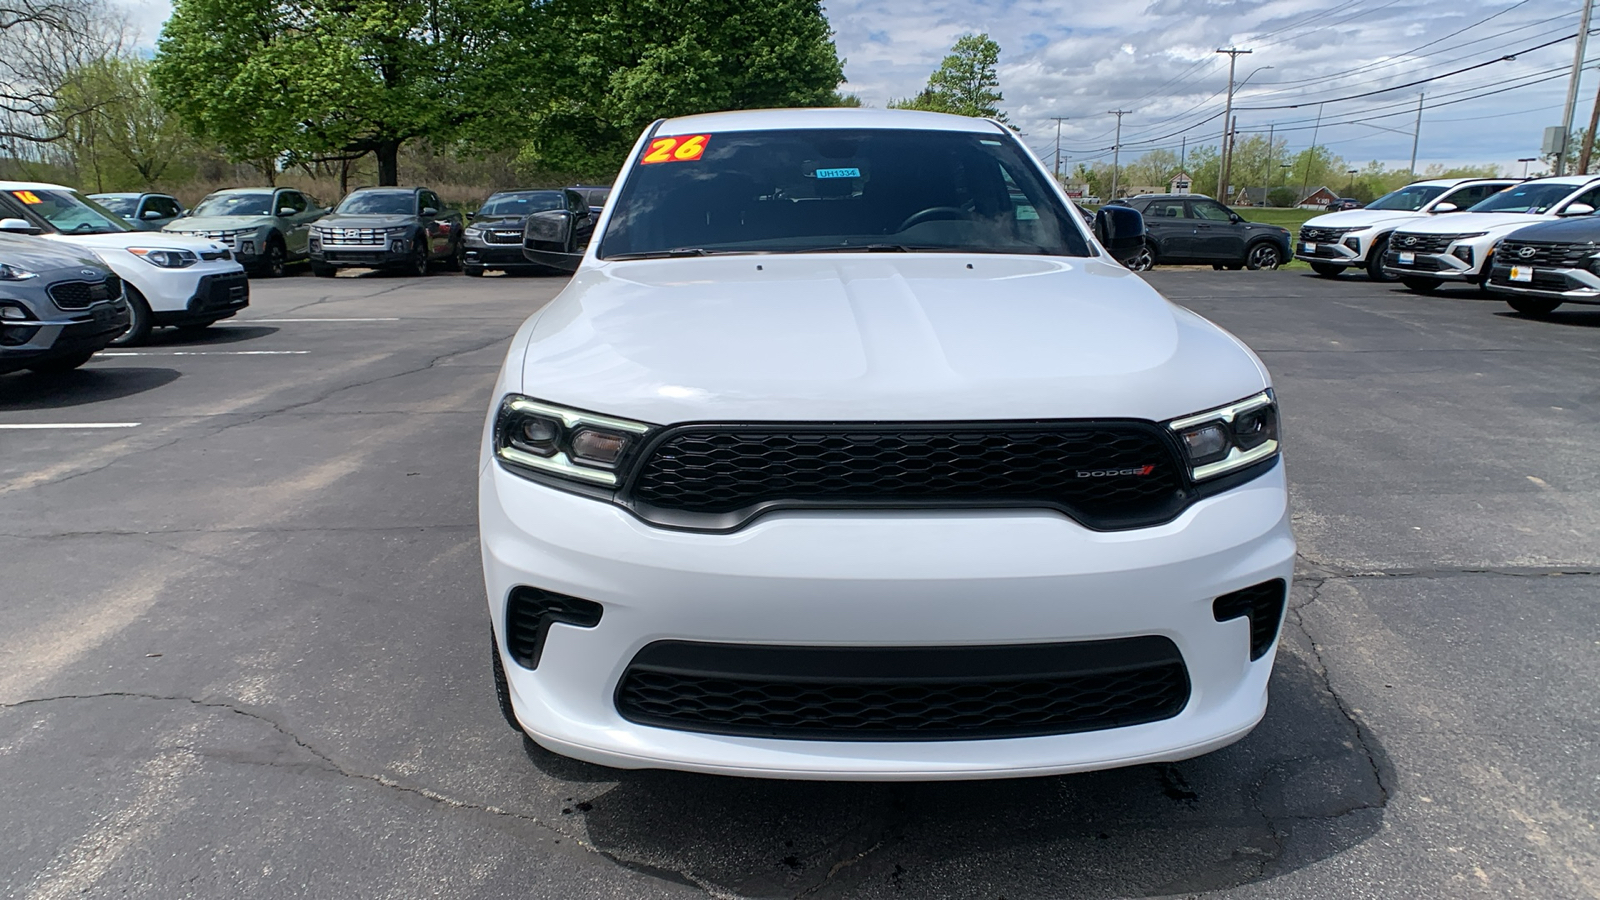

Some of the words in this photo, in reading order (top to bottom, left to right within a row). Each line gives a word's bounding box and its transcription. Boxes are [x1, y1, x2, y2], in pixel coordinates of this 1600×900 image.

[644, 135, 706, 163] 26
[819, 169, 857, 178] UH1334
[1076, 467, 1145, 478] DODGE
